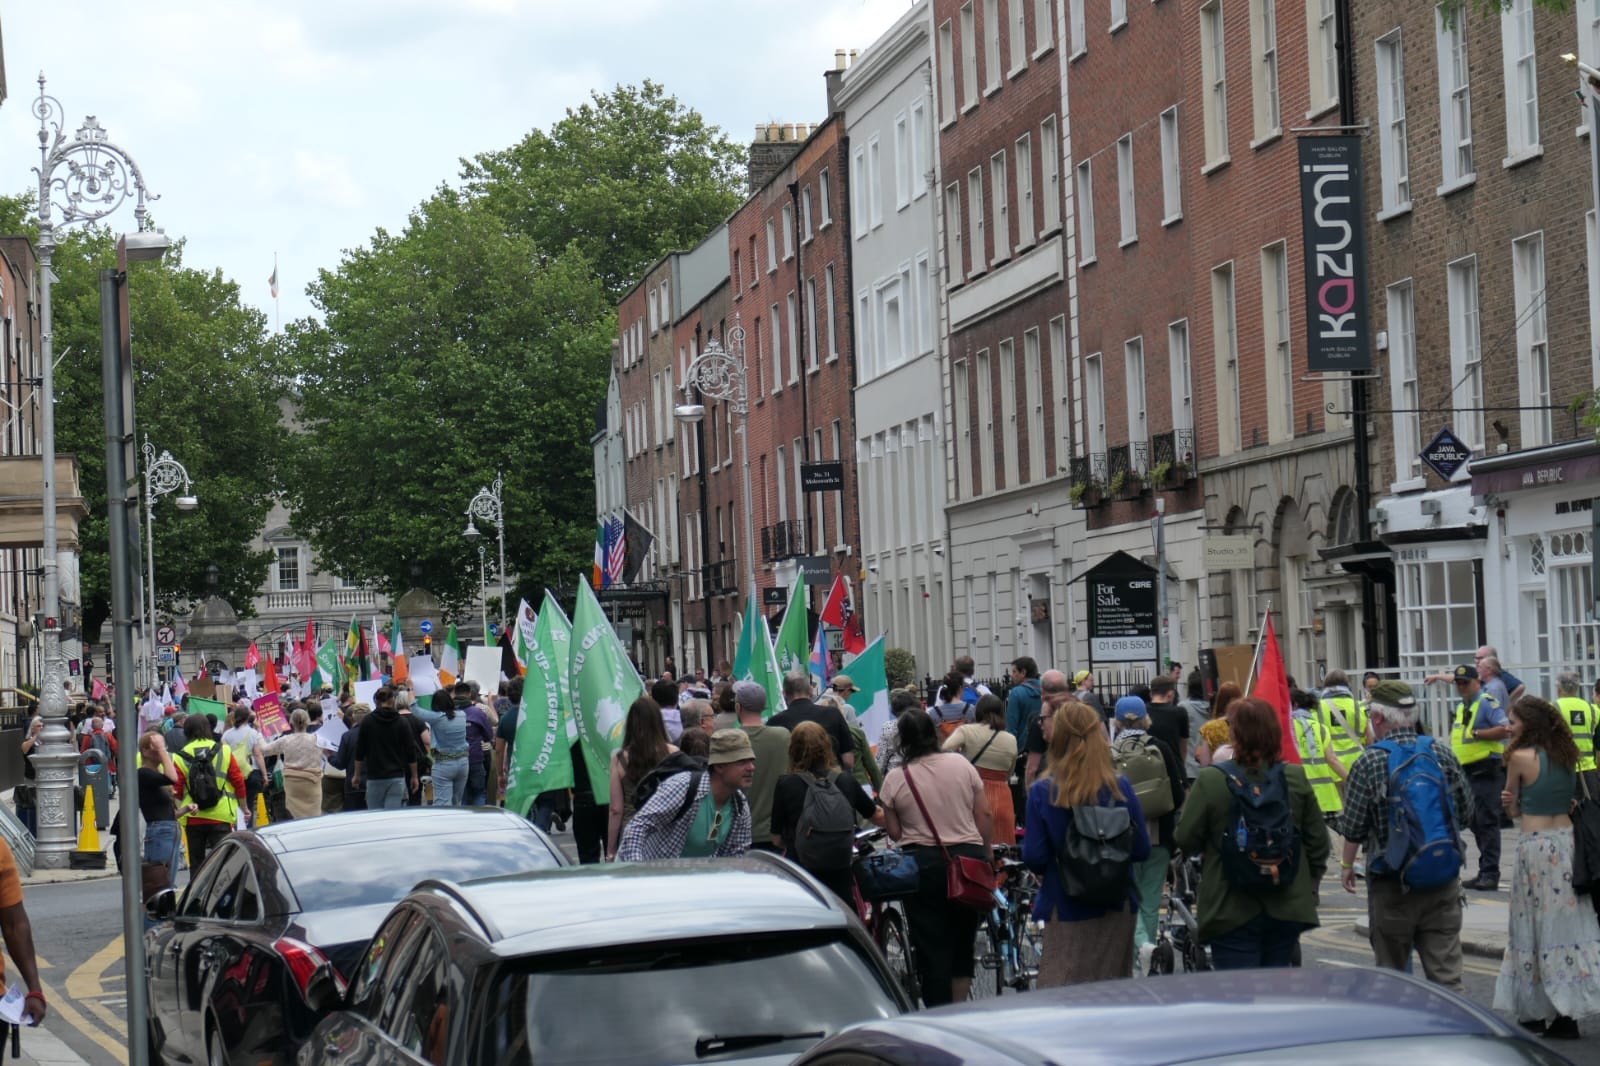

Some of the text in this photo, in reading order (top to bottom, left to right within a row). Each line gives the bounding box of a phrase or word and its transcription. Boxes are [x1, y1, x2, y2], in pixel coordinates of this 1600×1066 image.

[1429, 453, 1465, 461] REPUBLIC
[1536, 467, 1564, 483] REPUBLIC
[1097, 584, 1116, 595] For
[1097, 595, 1121, 606] Sale
[1099, 640, 1154, 651] 01 618 5500
[534, 650, 551, 670] UP
[545, 682, 559, 731] FIGHT
[531, 731, 557, 774] BACK
